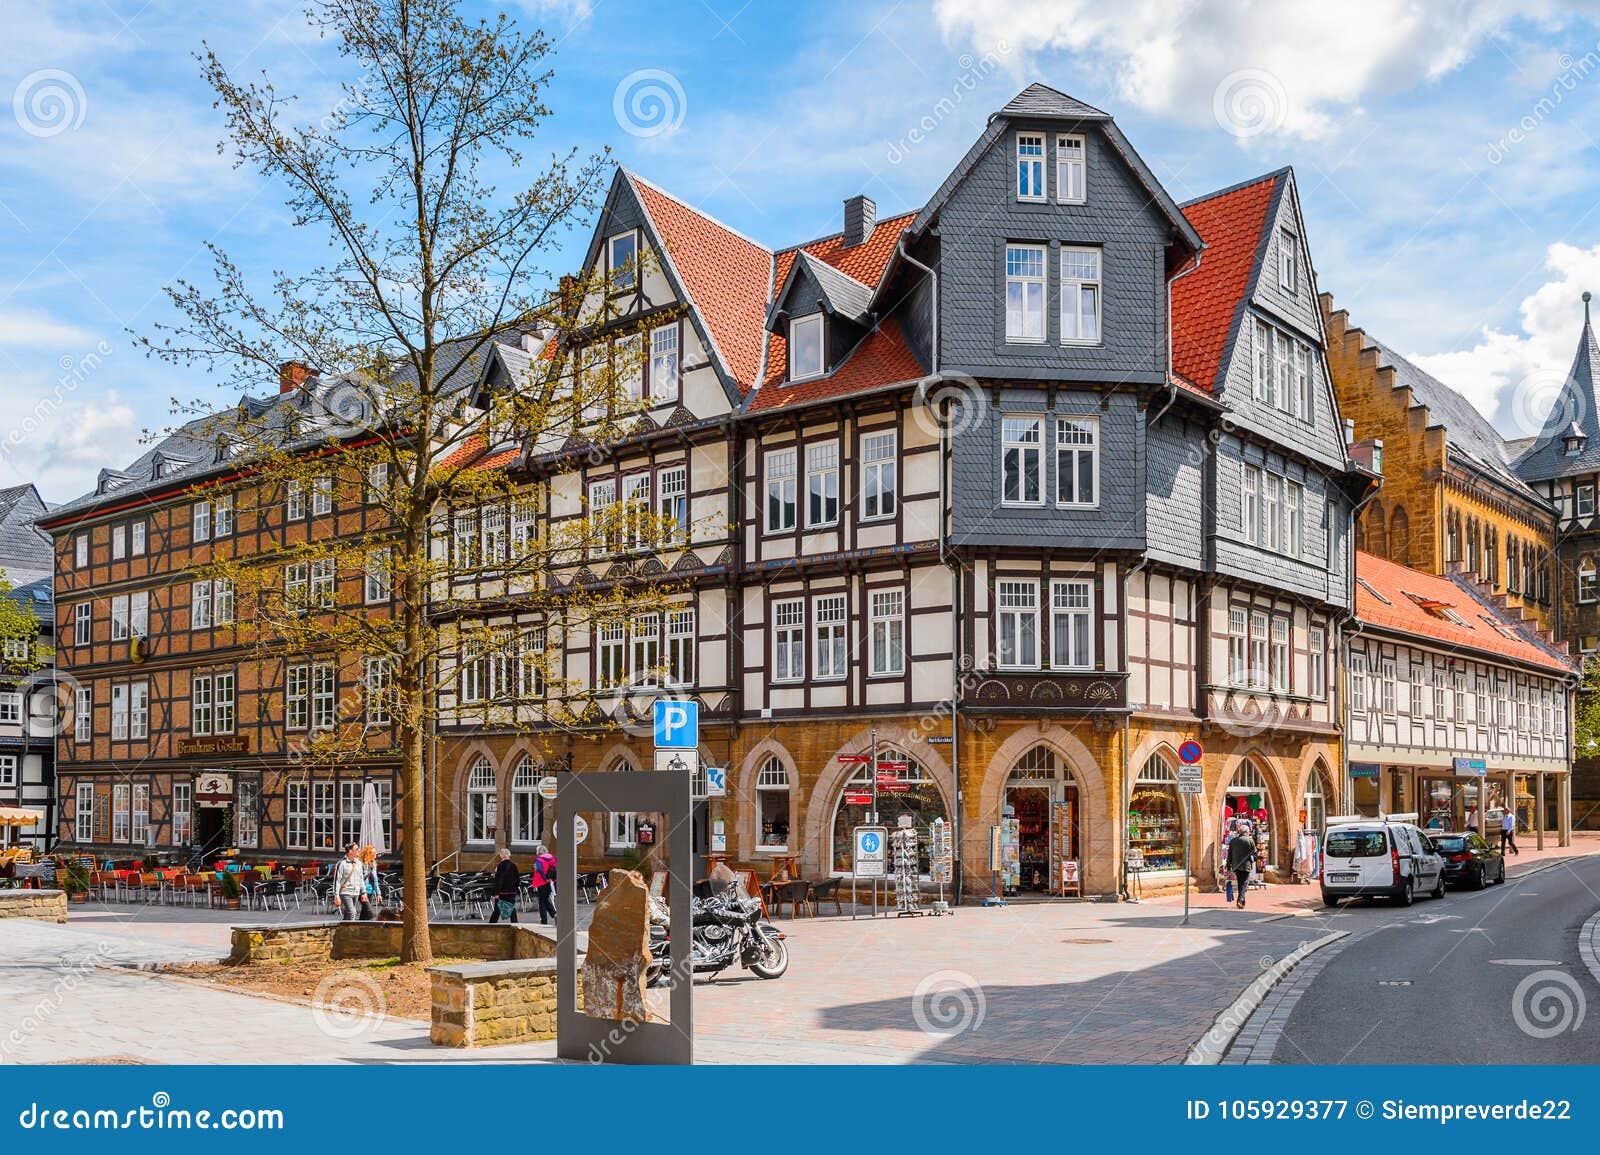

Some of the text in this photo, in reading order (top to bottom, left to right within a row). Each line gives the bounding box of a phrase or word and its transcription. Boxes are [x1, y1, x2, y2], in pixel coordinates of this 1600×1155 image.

[665, 707, 688, 741] P
[177, 737, 244, 754] Brauhaus Goslar
[708, 769, 724, 789] TK
